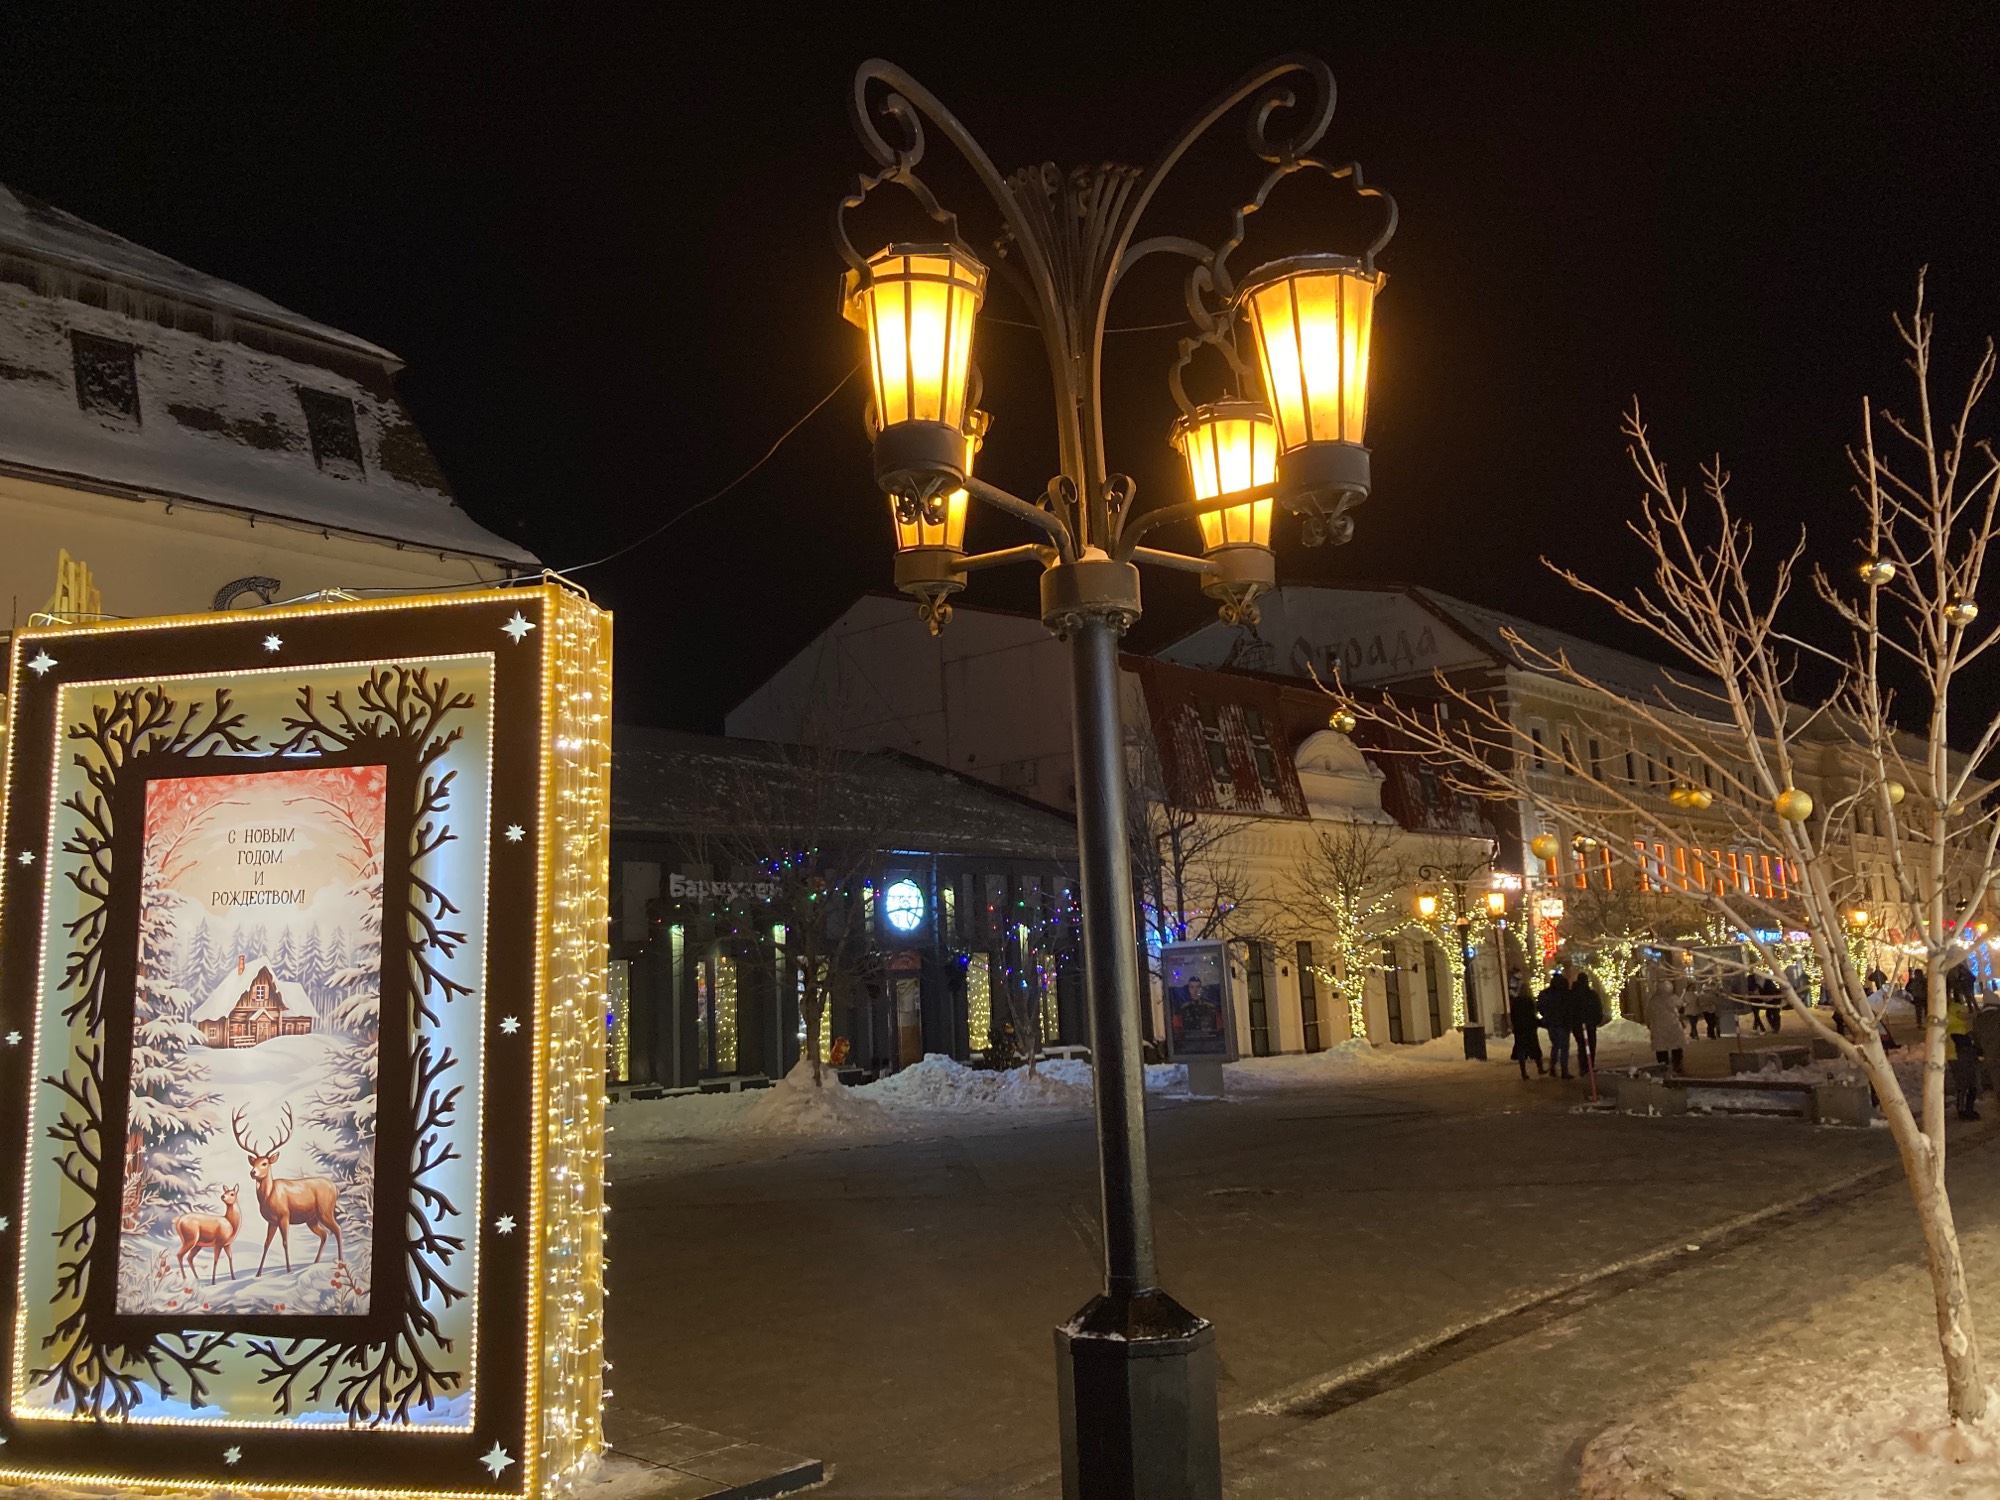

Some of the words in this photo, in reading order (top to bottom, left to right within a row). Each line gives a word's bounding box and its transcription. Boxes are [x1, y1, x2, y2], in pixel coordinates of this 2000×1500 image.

[1290, 625, 1440, 682] Отрада
[228, 829, 236, 844] С
[245, 828, 295, 844] НОВЫМ
[237, 850, 283, 866] ГОДОМ
[254, 871, 264, 886] И
[211, 889, 306, 907] РОЖДЕСТВОМ!
